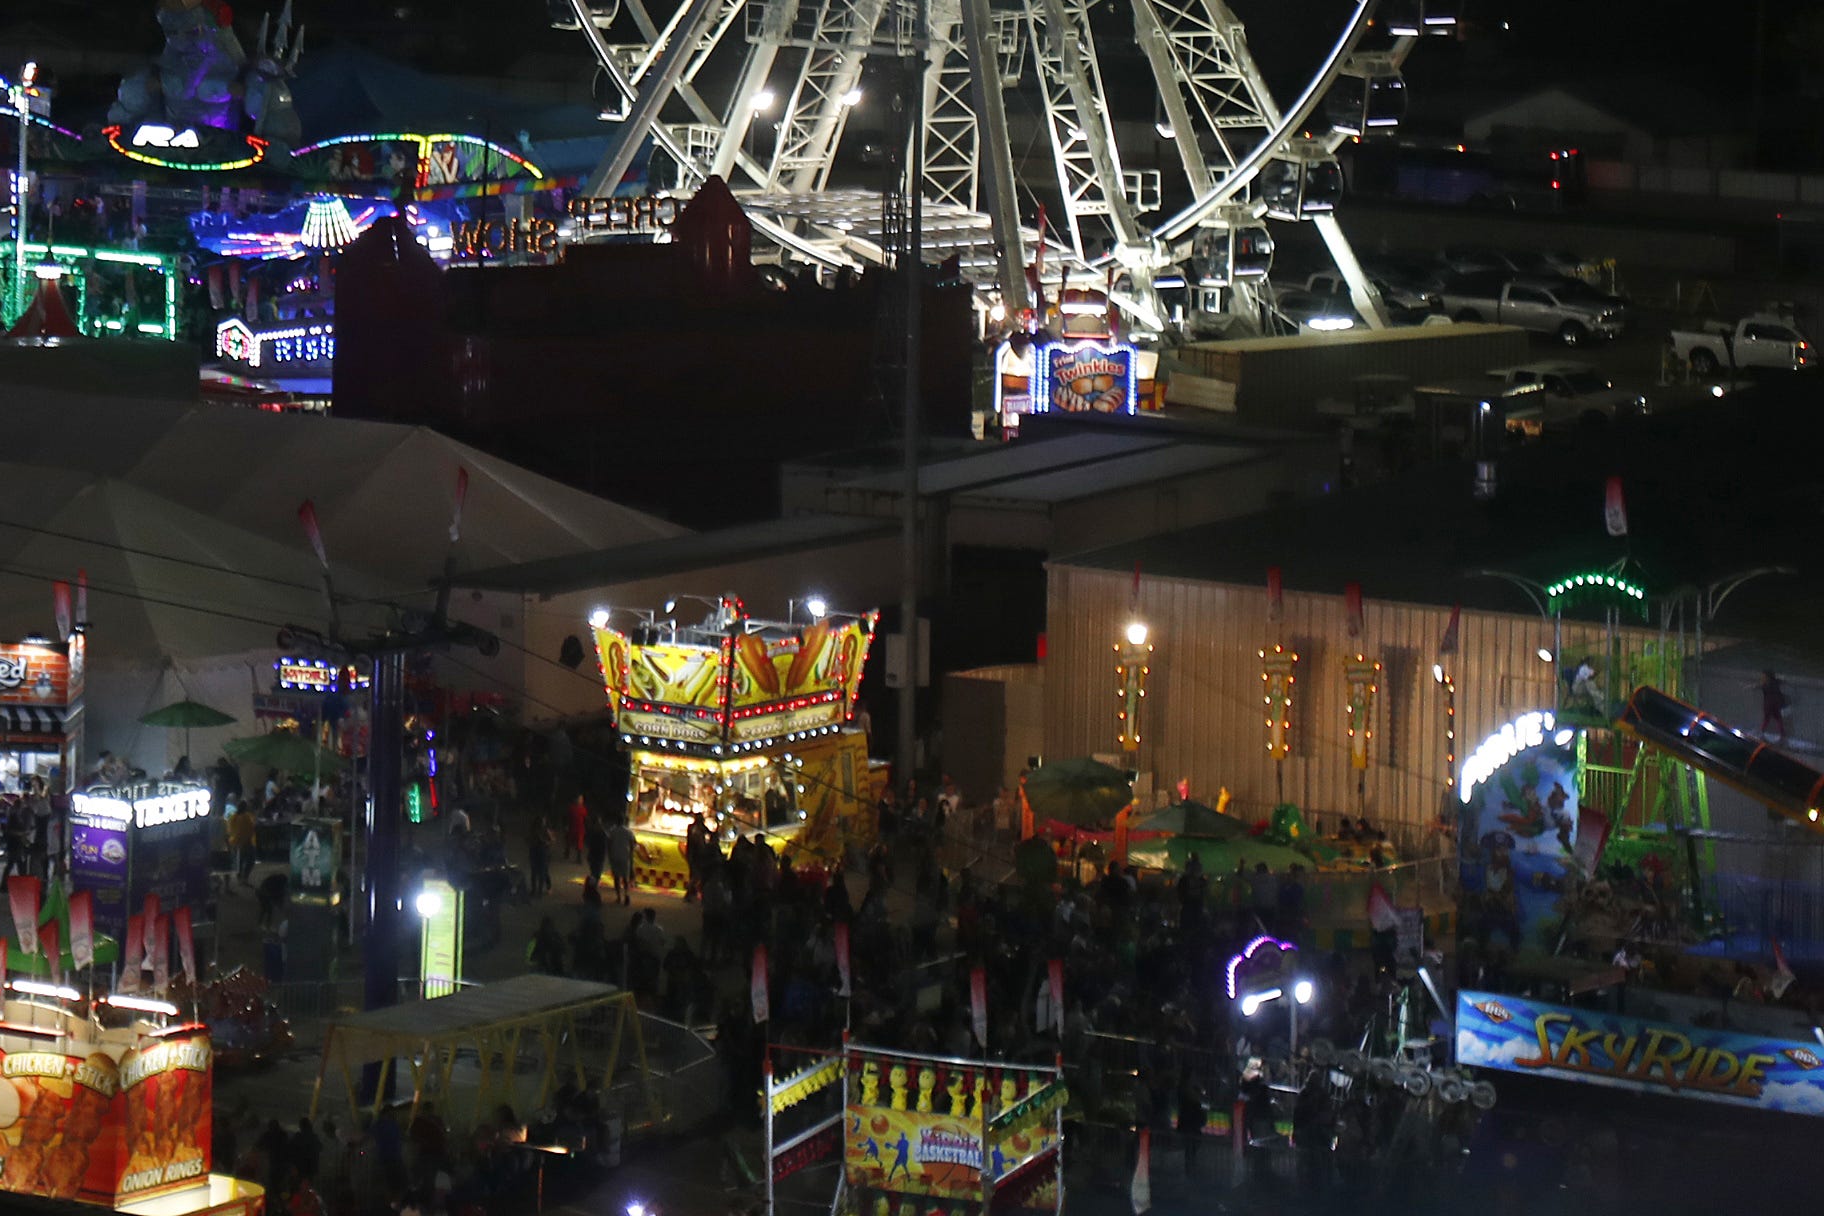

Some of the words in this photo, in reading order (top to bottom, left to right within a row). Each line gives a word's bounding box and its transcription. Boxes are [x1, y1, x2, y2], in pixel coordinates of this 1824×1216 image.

[1055, 358, 1126, 386] Twinkies
[133, 789, 211, 828] TICKETS
[4, 1057, 64, 1074] CHICKEN
[75, 1063, 114, 1096] STICK
[120, 1047, 169, 1089] CHICKEN
[178, 1044, 208, 1068] STICK
[914, 1143, 983, 1170] BASKETBAL
[122, 1168, 163, 1192] ONION
[166, 1159, 202, 1182] RINGS
